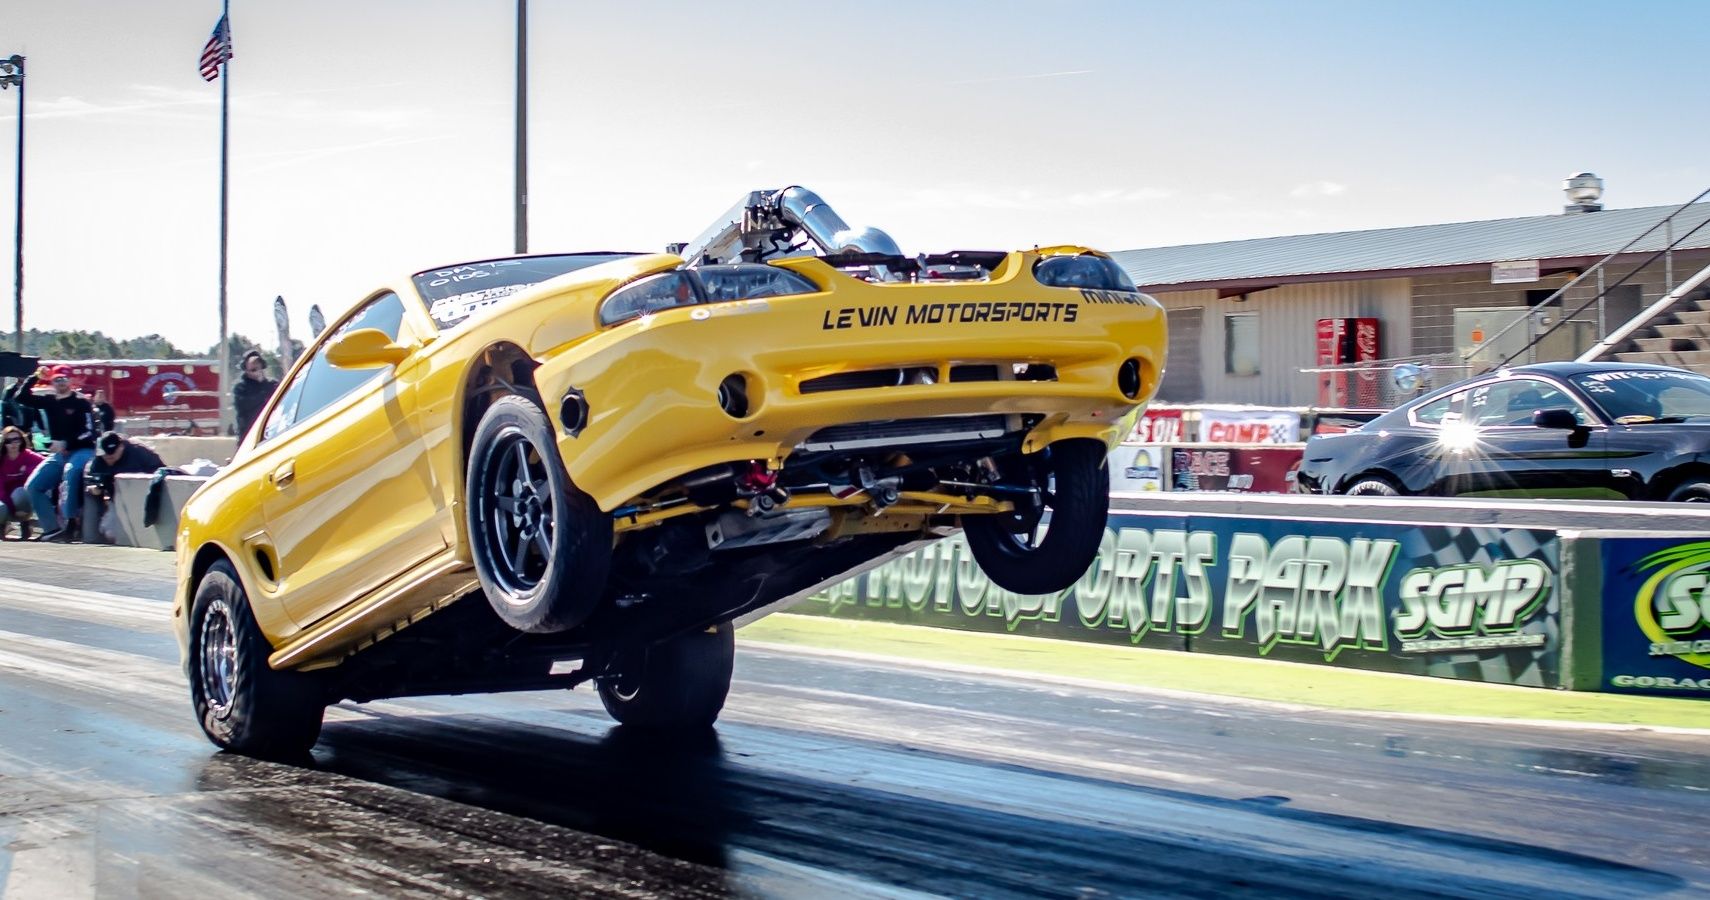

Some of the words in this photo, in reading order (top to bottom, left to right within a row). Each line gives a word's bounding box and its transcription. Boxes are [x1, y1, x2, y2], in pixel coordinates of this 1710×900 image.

[822, 306, 898, 330] LEVIN
[905, 302, 1079, 325] MOTORSPORTS
[1221, 532, 1400, 663] PARK
[1396, 557, 1553, 641] SGMP
